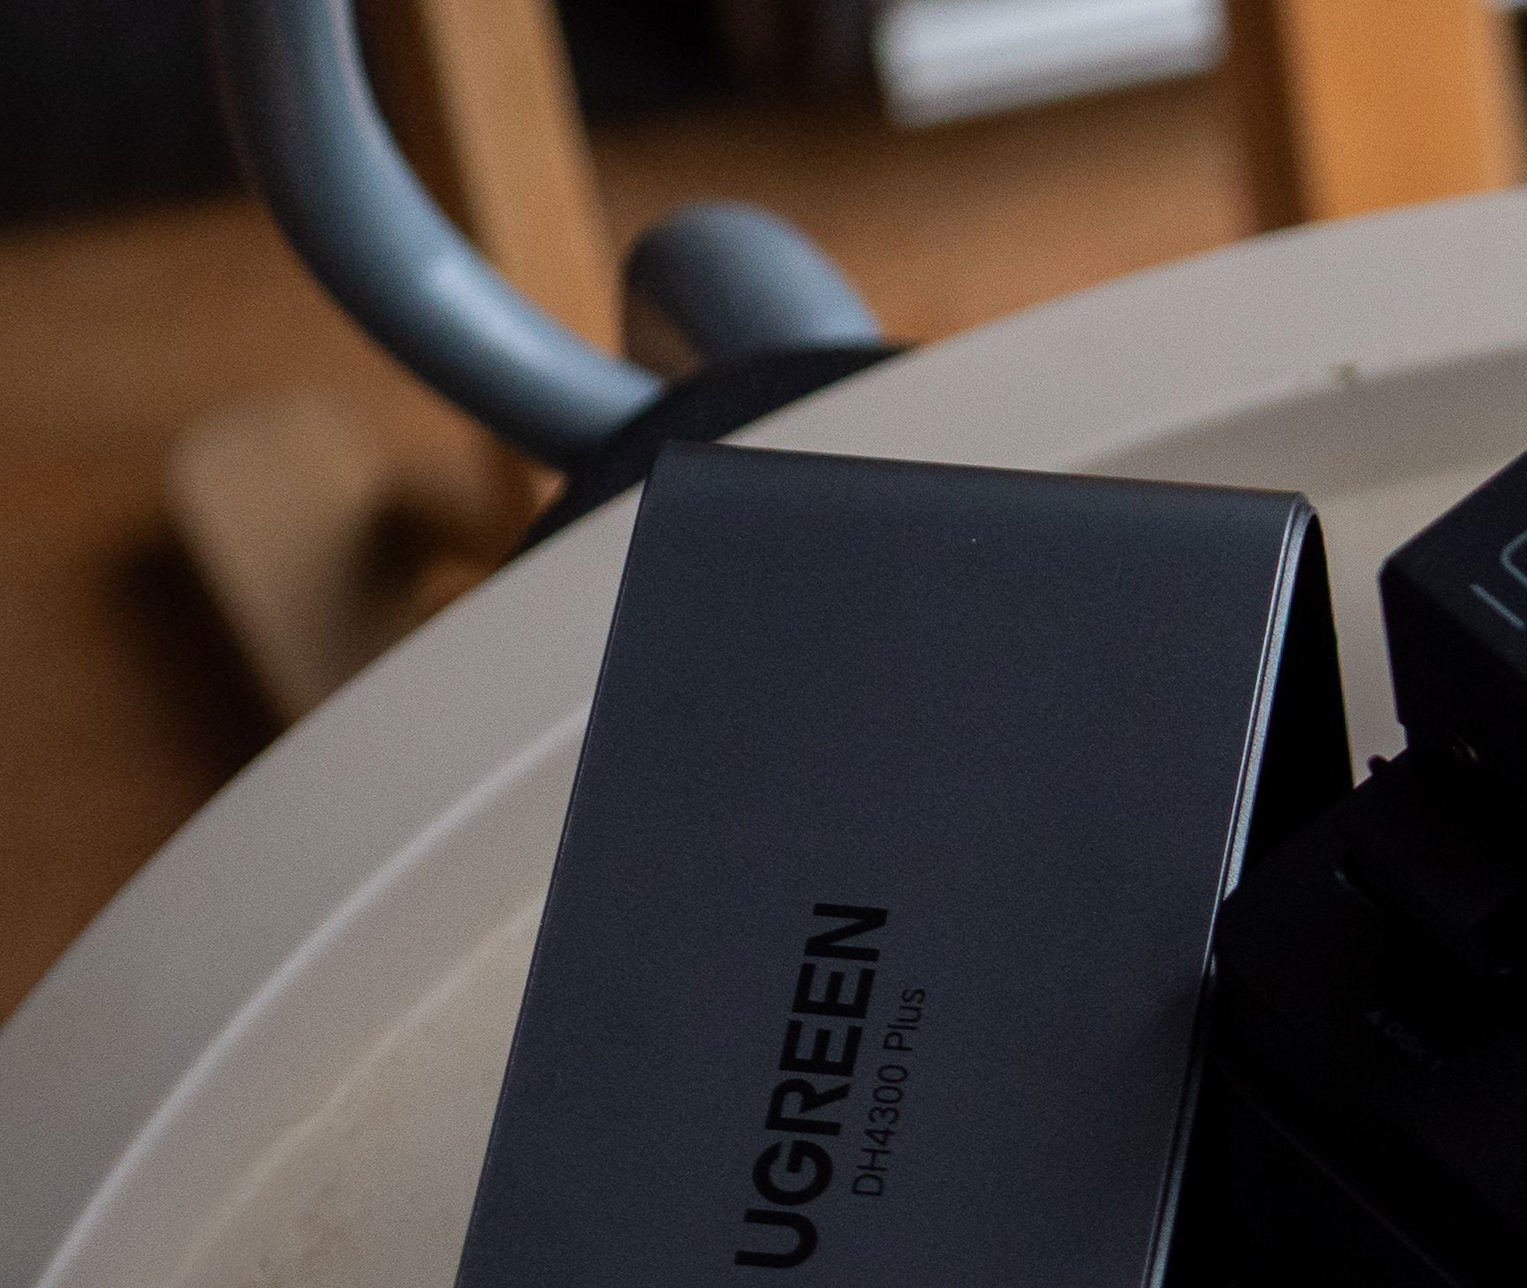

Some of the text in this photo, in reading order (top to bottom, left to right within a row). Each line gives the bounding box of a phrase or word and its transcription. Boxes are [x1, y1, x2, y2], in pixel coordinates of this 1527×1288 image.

[734, 903, 888, 1269] UGREEN
[852, 988, 926, 1197] DH4300 Plus
